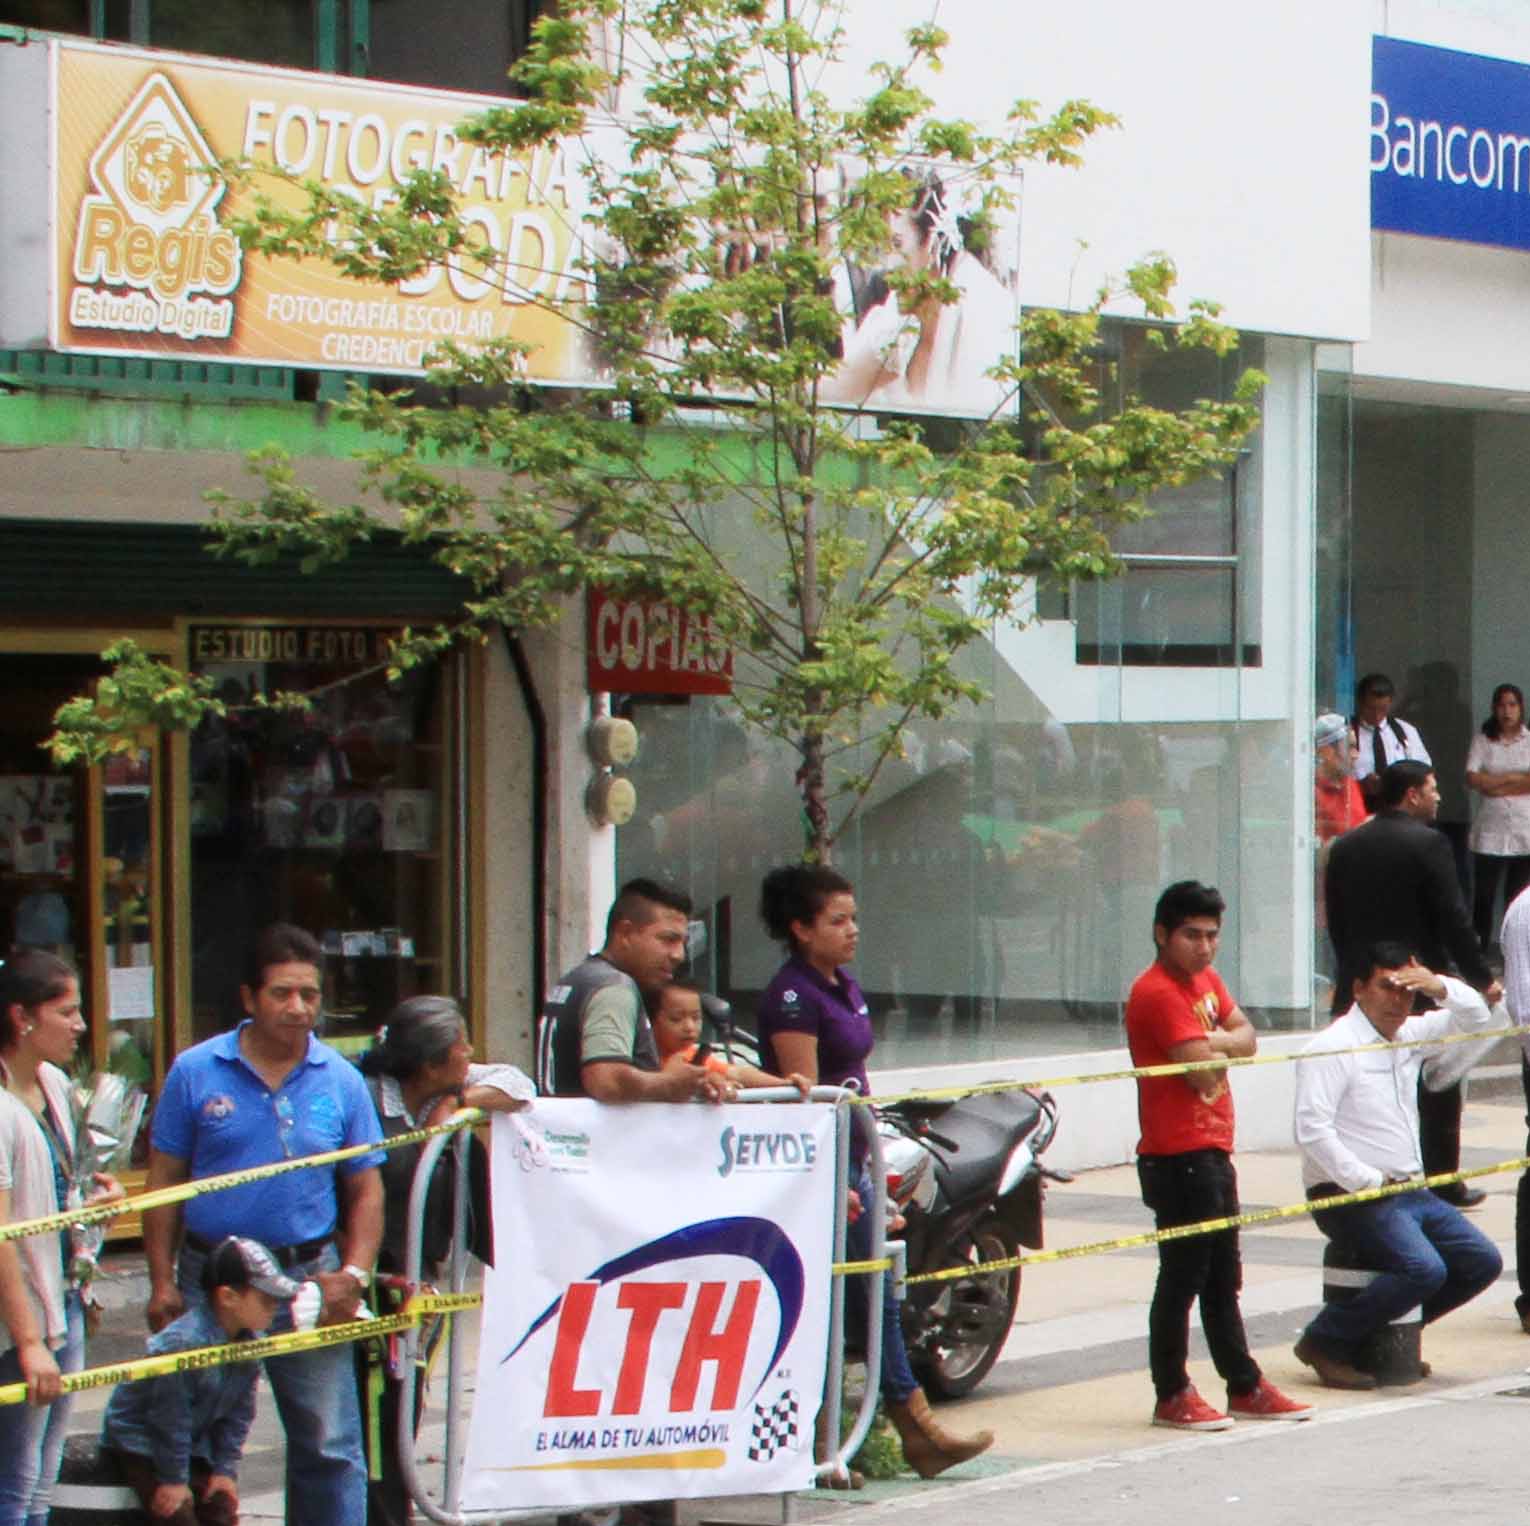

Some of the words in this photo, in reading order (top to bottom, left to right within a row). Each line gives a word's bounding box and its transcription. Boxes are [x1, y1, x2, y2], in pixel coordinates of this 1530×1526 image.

[78, 202, 236, 299] Regis
[398, 204, 598, 306] ODA
[75, 293, 155, 323] Estudio
[162, 301, 229, 332] Digital
[266, 295, 401, 329] FOTOGRAFÍA
[403, 303, 493, 337] ESCOLAR
[195, 628, 298, 658] ESTUDIO
[307, 630, 366, 659] FOTO
[542, 1279, 762, 1418] LTH
[535, 1432, 548, 1452] EL
[551, 1430, 597, 1449] ALMA
[601, 1429, 619, 1448] DE
[624, 1428, 642, 1447] TU
[646, 1418, 730, 1446] AUTOMÓVIL
